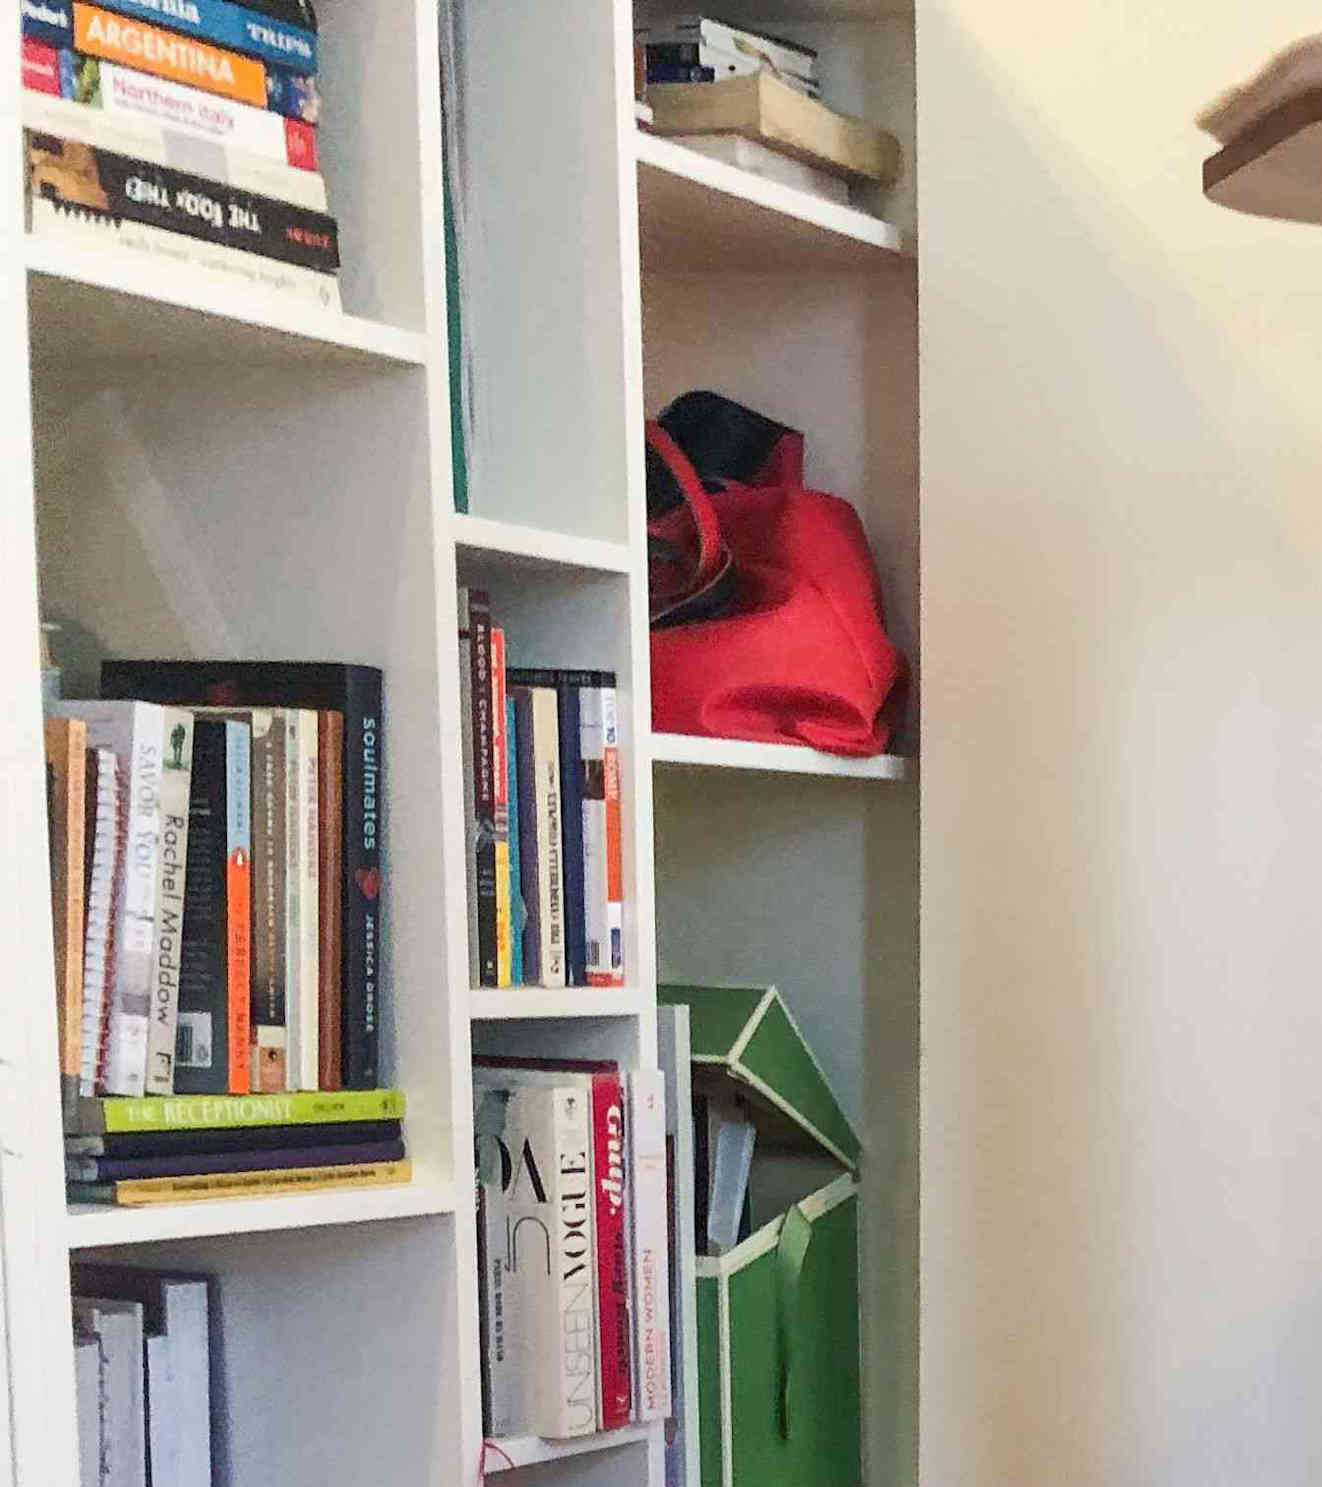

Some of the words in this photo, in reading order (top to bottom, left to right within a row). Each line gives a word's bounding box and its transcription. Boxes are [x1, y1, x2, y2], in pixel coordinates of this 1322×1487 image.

[85, 14, 235, 85] ARGENTINA
[361, 716, 378, 852] soulmates
[161, 815, 185, 901] Rachel
[155, 907, 180, 1027] Maddow
[364, 912, 376, 978] JESSICA
[164, 1098, 291, 1126] RECEPTIONIST
[601, 1105, 624, 1215] Gulp.
[559, 1151, 588, 1281] VOGUE
[641, 1248, 655, 1323] WOMEN
[560, 1283, 593, 1431] UNSEEN
[643, 1327, 656, 1411] MODERN
